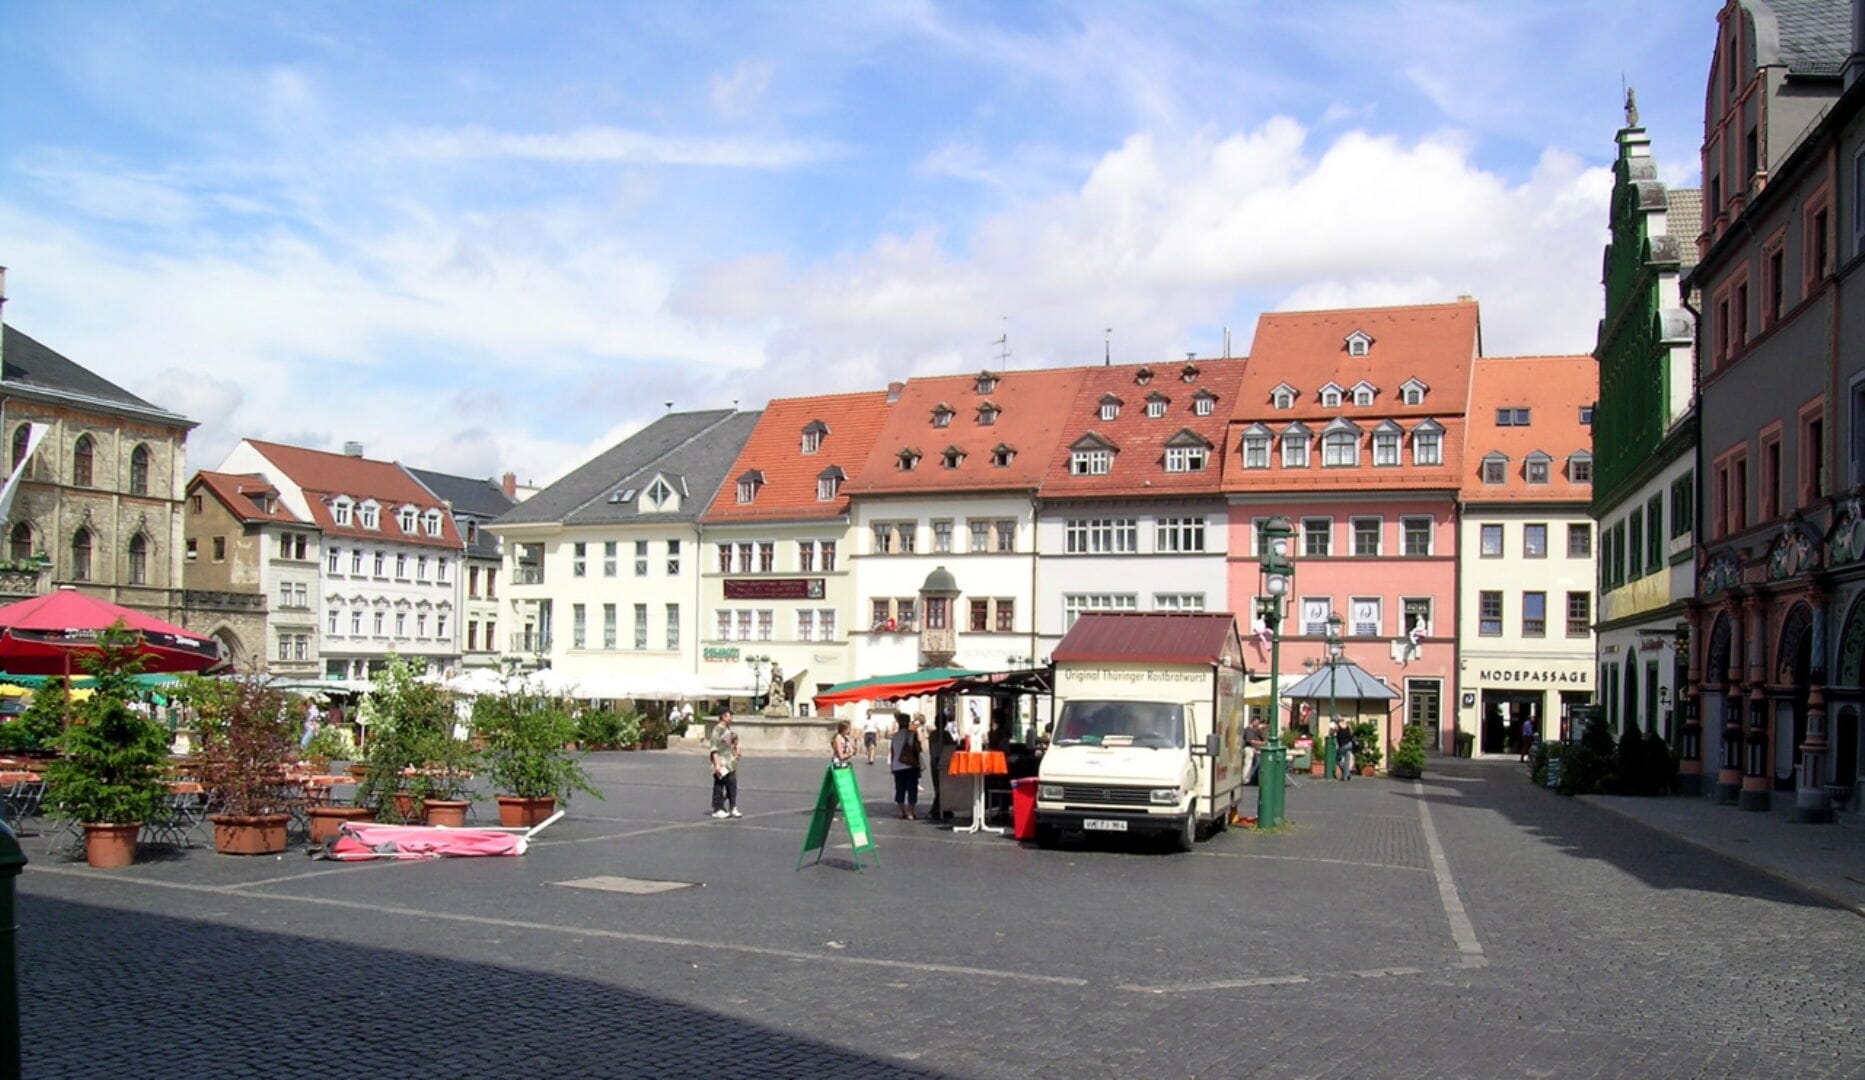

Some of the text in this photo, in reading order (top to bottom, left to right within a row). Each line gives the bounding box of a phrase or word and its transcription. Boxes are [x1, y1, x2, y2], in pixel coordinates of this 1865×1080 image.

[1065, 668, 1206, 684] Original Thüringer Rostbratwurst
[1480, 670, 1587, 682] MODEPASSAGE
